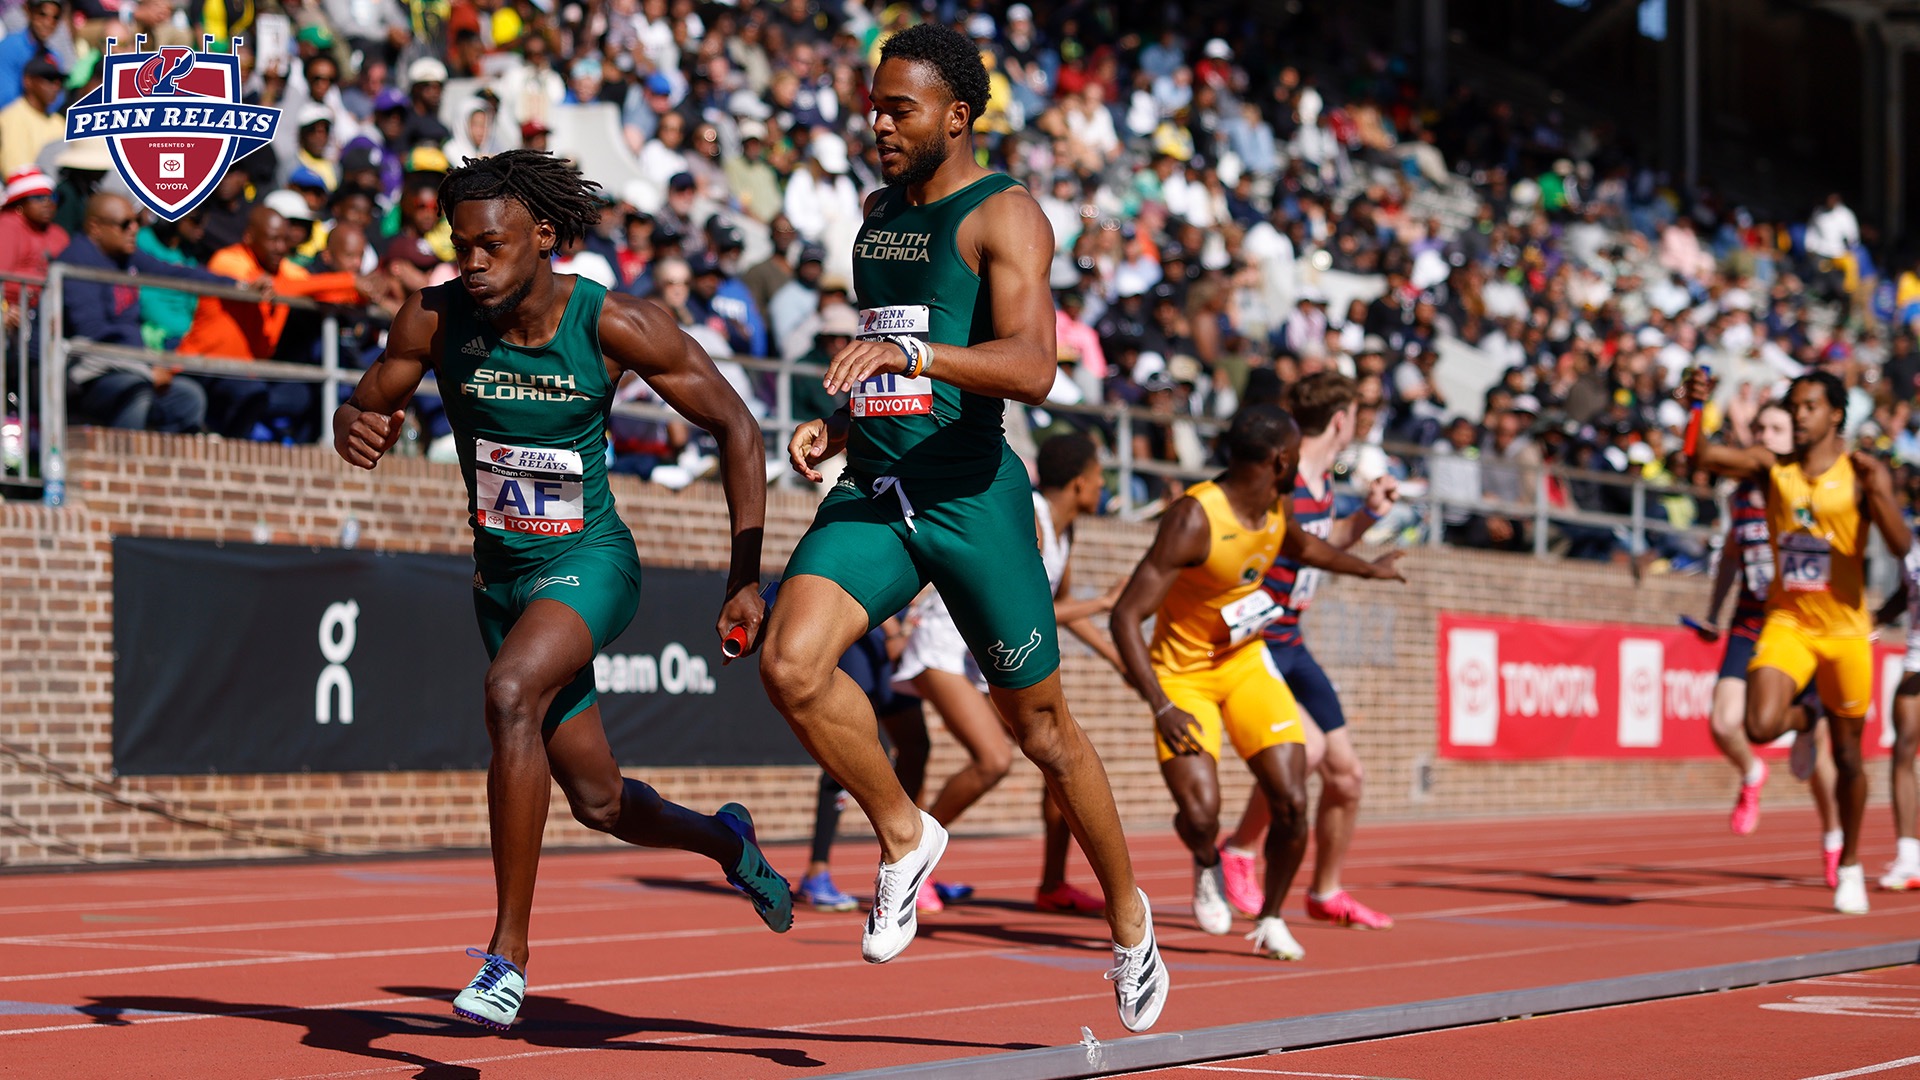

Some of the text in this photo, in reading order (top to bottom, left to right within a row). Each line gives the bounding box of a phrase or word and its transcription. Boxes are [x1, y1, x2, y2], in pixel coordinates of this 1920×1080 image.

[863, 229, 931, 246] SOUTH
[853, 243, 930, 263] FLORIDA
[879, 309, 905, 319] PENN
[876, 319, 915, 329] RELAYS
[461, 346, 490, 358] adidas
[473, 368, 576, 389] SOUTH
[461, 383, 591, 402] FLORIDA
[868, 398, 923, 412] TOYOTA
[520, 450, 557, 462] PENN
[491, 465, 518, 477] Dream
[518, 458, 568, 471] RELAYS
[493, 479, 563, 517] AF
[507, 518, 573, 533] TOYOTA
[593, 642, 716, 695] eam On.
[1501, 660, 1600, 718] TOYOTA
